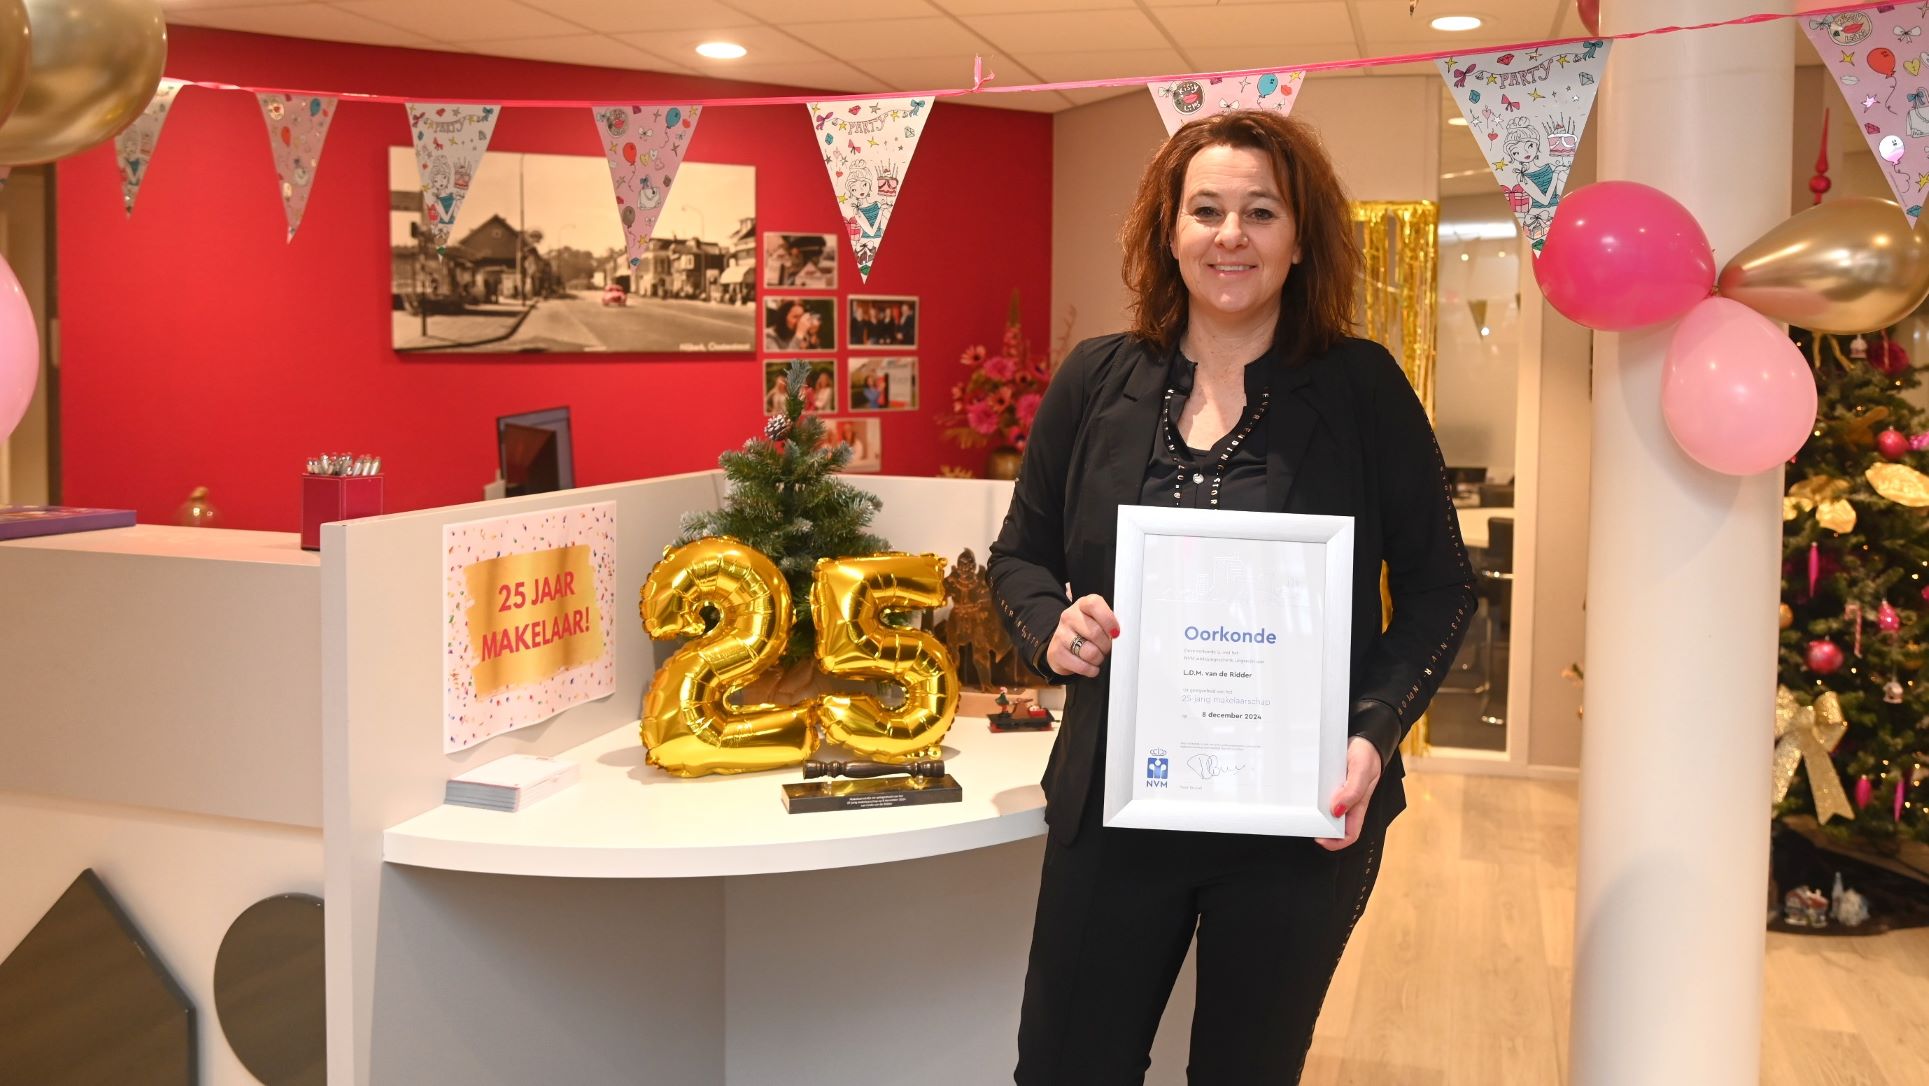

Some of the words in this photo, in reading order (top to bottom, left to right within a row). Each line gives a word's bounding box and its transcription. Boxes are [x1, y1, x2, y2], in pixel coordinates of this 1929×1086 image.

[1499, 58, 1554, 89] PARTY
[848, 112, 889, 135] PARTY
[498, 583, 527, 613] 25
[531, 571, 576, 606] JAAR
[481, 606, 590, 662] MAKELAAR!
[1184, 626, 1277, 644] Oorkonde
[1219, 669, 1228, 677] de
[1229, 671, 1253, 679] Ridder
[1208, 711, 1243, 719] december
[1145, 779, 1168, 789] NVM
